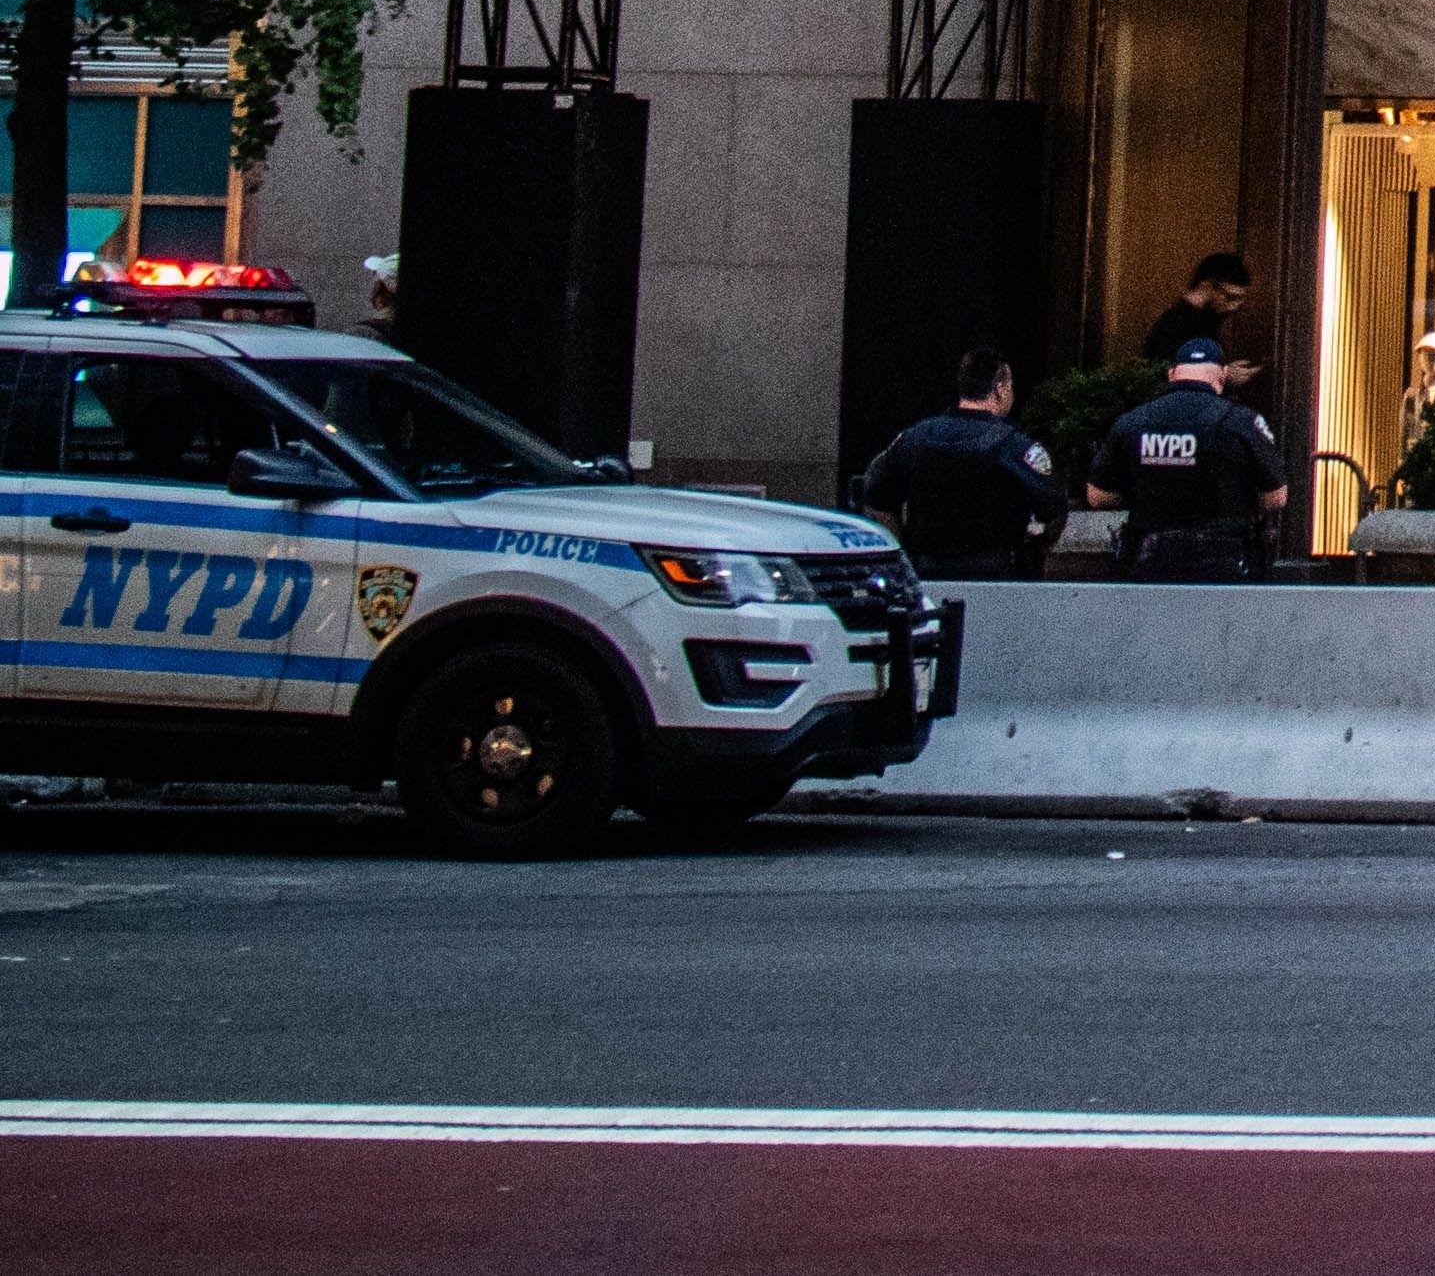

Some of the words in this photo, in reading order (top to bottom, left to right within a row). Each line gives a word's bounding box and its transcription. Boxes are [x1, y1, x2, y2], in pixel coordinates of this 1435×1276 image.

[1141, 433, 1197, 458] NYPD
[498, 529, 598, 564] POLICE
[59, 544, 314, 641] NYPD
